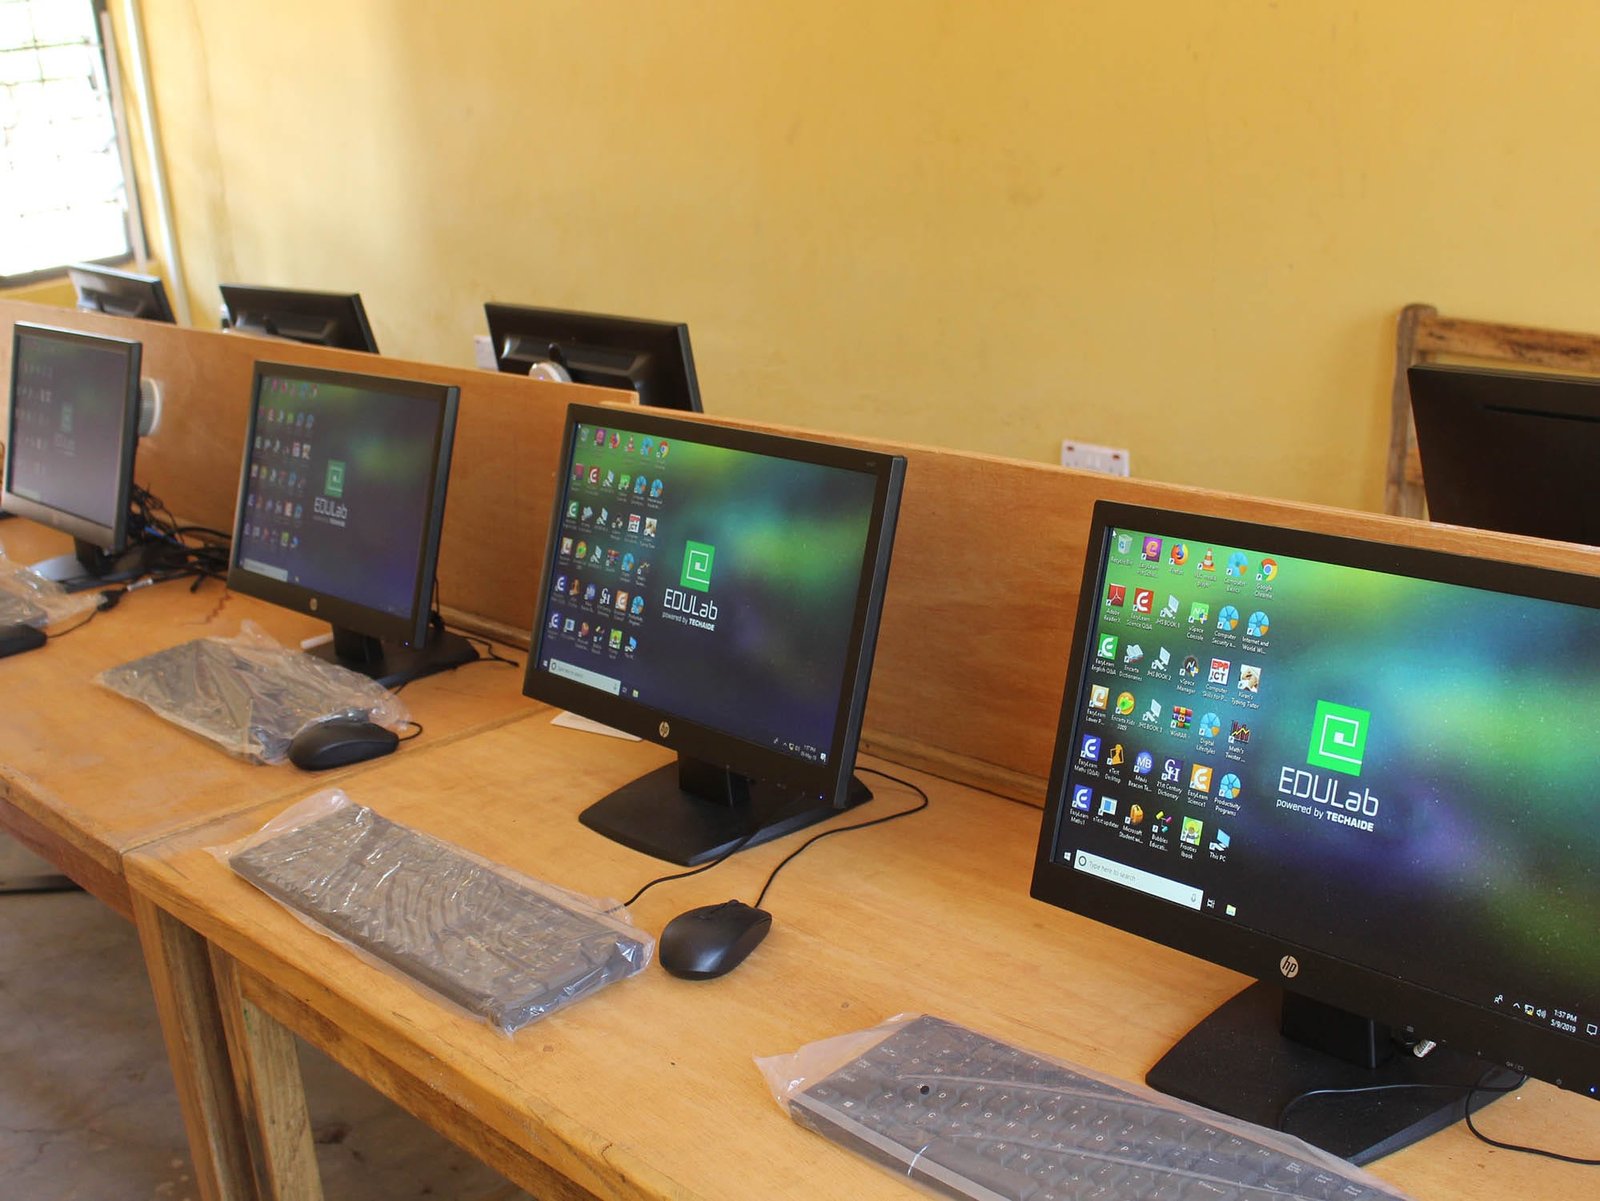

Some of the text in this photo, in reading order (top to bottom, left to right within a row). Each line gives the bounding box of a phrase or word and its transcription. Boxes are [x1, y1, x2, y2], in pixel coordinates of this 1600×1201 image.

[1256, 583, 1273, 592] Google
[663, 588, 718, 620] EDULab
[688, 618, 715, 631] TECHAIDE
[1165, 620, 1177, 628] BOOK
[1186, 632, 1204, 641] Console
[1214, 630, 1236, 640] Computer
[1242, 636, 1259, 645] Internet
[1211, 638, 1229, 647] Security
[1241, 644, 1256, 652] World
[1091, 664, 1106, 673] English
[1205, 684, 1229, 694] Computer
[1231, 697, 1260, 710] Typing Tutor
[1147, 723, 1159, 732] BOOK
[1200, 737, 1215, 746] Digital
[1137, 756, 1152, 769] MB
[1128, 780, 1143, 789] Beacon
[1166, 783, 1183, 794] Century
[1157, 788, 1179, 801] Dictionary
[1187, 789, 1208, 800] EasyLearn
[1278, 765, 1380, 817] EDULab
[1214, 796, 1241, 811] Productivity
[1215, 805, 1237, 817] Programs
[1276, 798, 1375, 833] powered by TECHAIDE
[1119, 831, 1134, 841] Student
[1122, 825, 1143, 836] Microsoft
[1209, 851, 1226, 862] This PC
[1088, 860, 1101, 872] Type
[1101, 864, 1113, 874] here
[1119, 871, 1137, 882] search
[1281, 955, 1298, 977] hp
[1553, 1009, 1578, 1023] 1:57 PM
[1550, 1018, 1577, 1034] 5/9/2019
